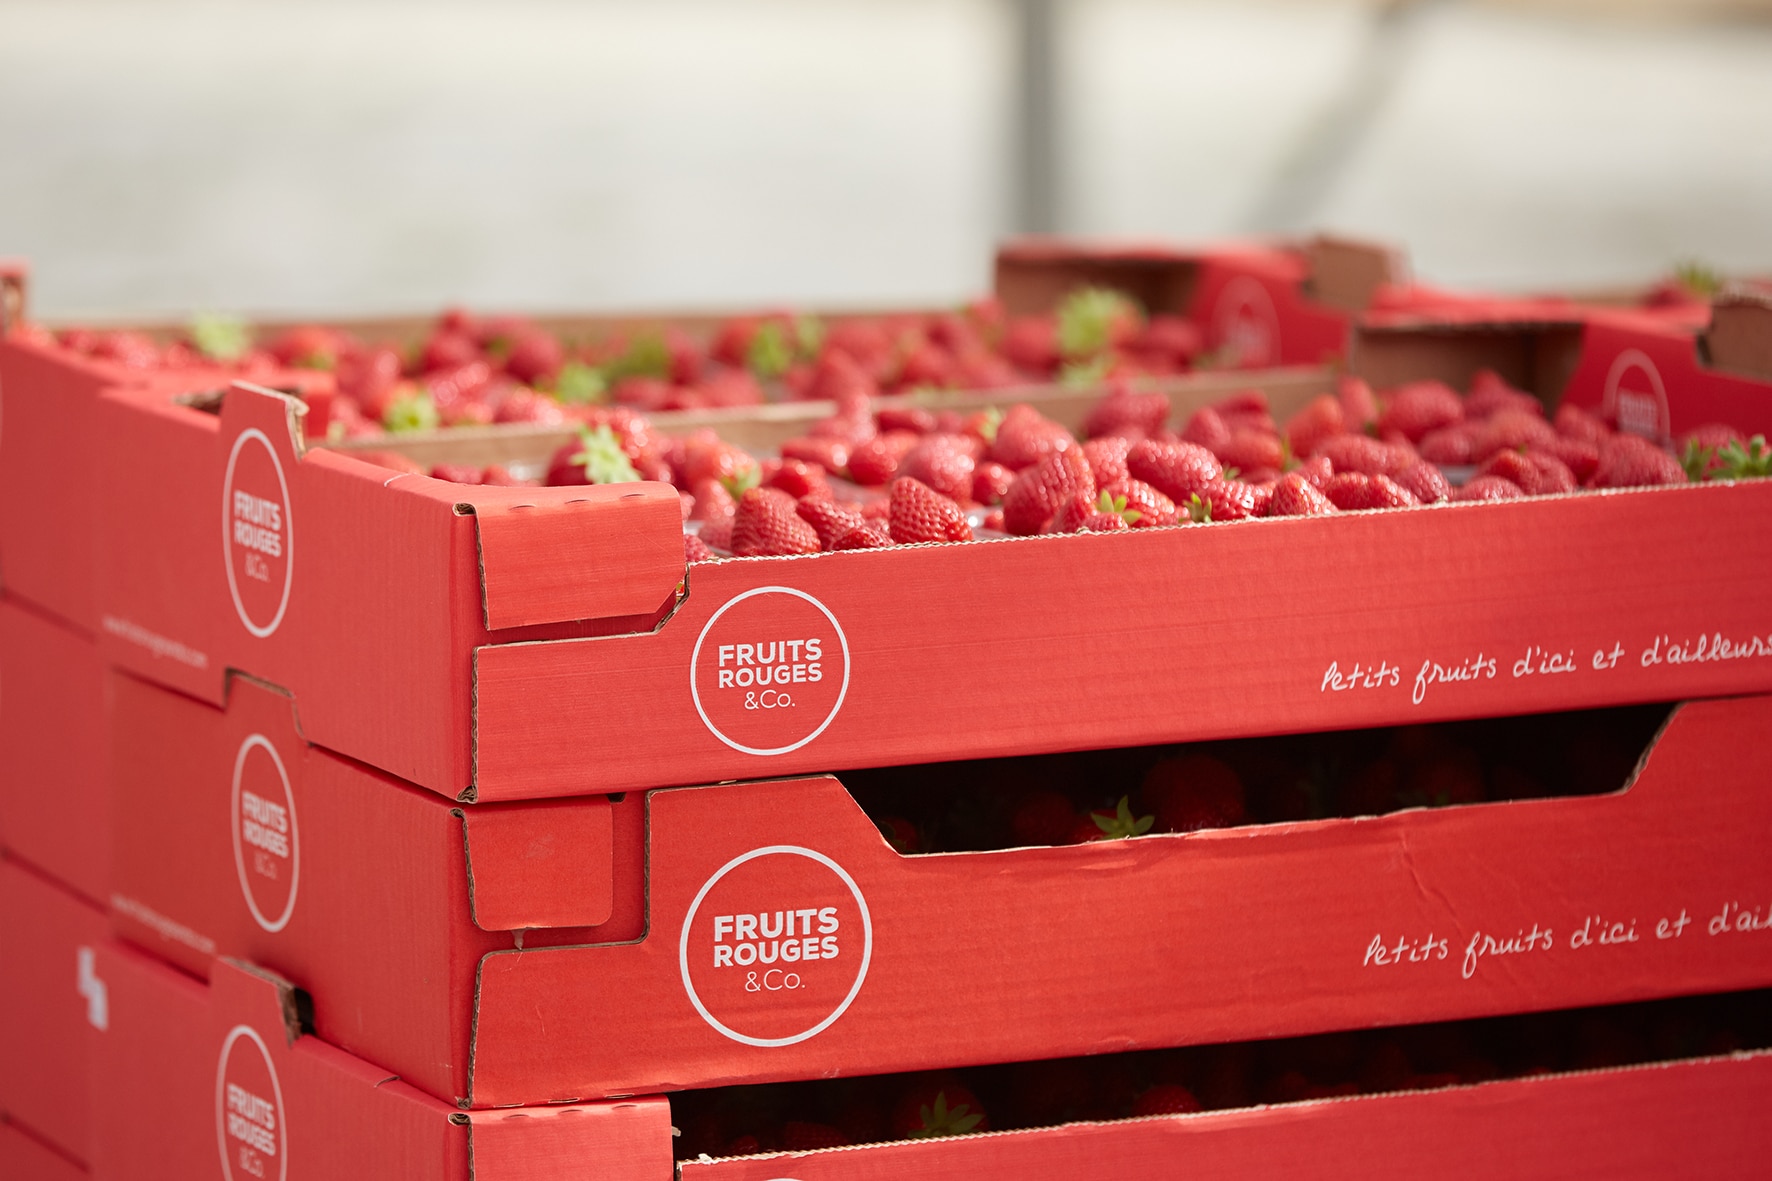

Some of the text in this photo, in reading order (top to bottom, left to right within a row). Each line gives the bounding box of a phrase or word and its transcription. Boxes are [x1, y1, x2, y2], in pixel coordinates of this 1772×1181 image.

[234, 489, 281, 531] FRUITS
[234, 519, 282, 558] ROUGES
[718, 638, 823, 668] FRUITS
[1320, 660, 1400, 693] Petits
[1411, 652, 1497, 705] fruits
[1512, 645, 1577, 678] d'ici
[1592, 640, 1626, 670] et
[718, 662, 823, 689] ROUGES
[744, 689, 796, 710] &Co.
[242, 790, 288, 834] FRUITS
[713, 906, 840, 943] FRUITS
[1363, 933, 1449, 967] Petits
[1461, 922, 1553, 980] fruits
[1570, 914, 1640, 950] d'ici
[1655, 908, 1692, 940] et
[713, 935, 840, 968] ROUGES
[744, 968, 806, 993] &Co.
[227, 1082, 275, 1131] FRUITS
[227, 1110, 276, 1157] ROUGES
